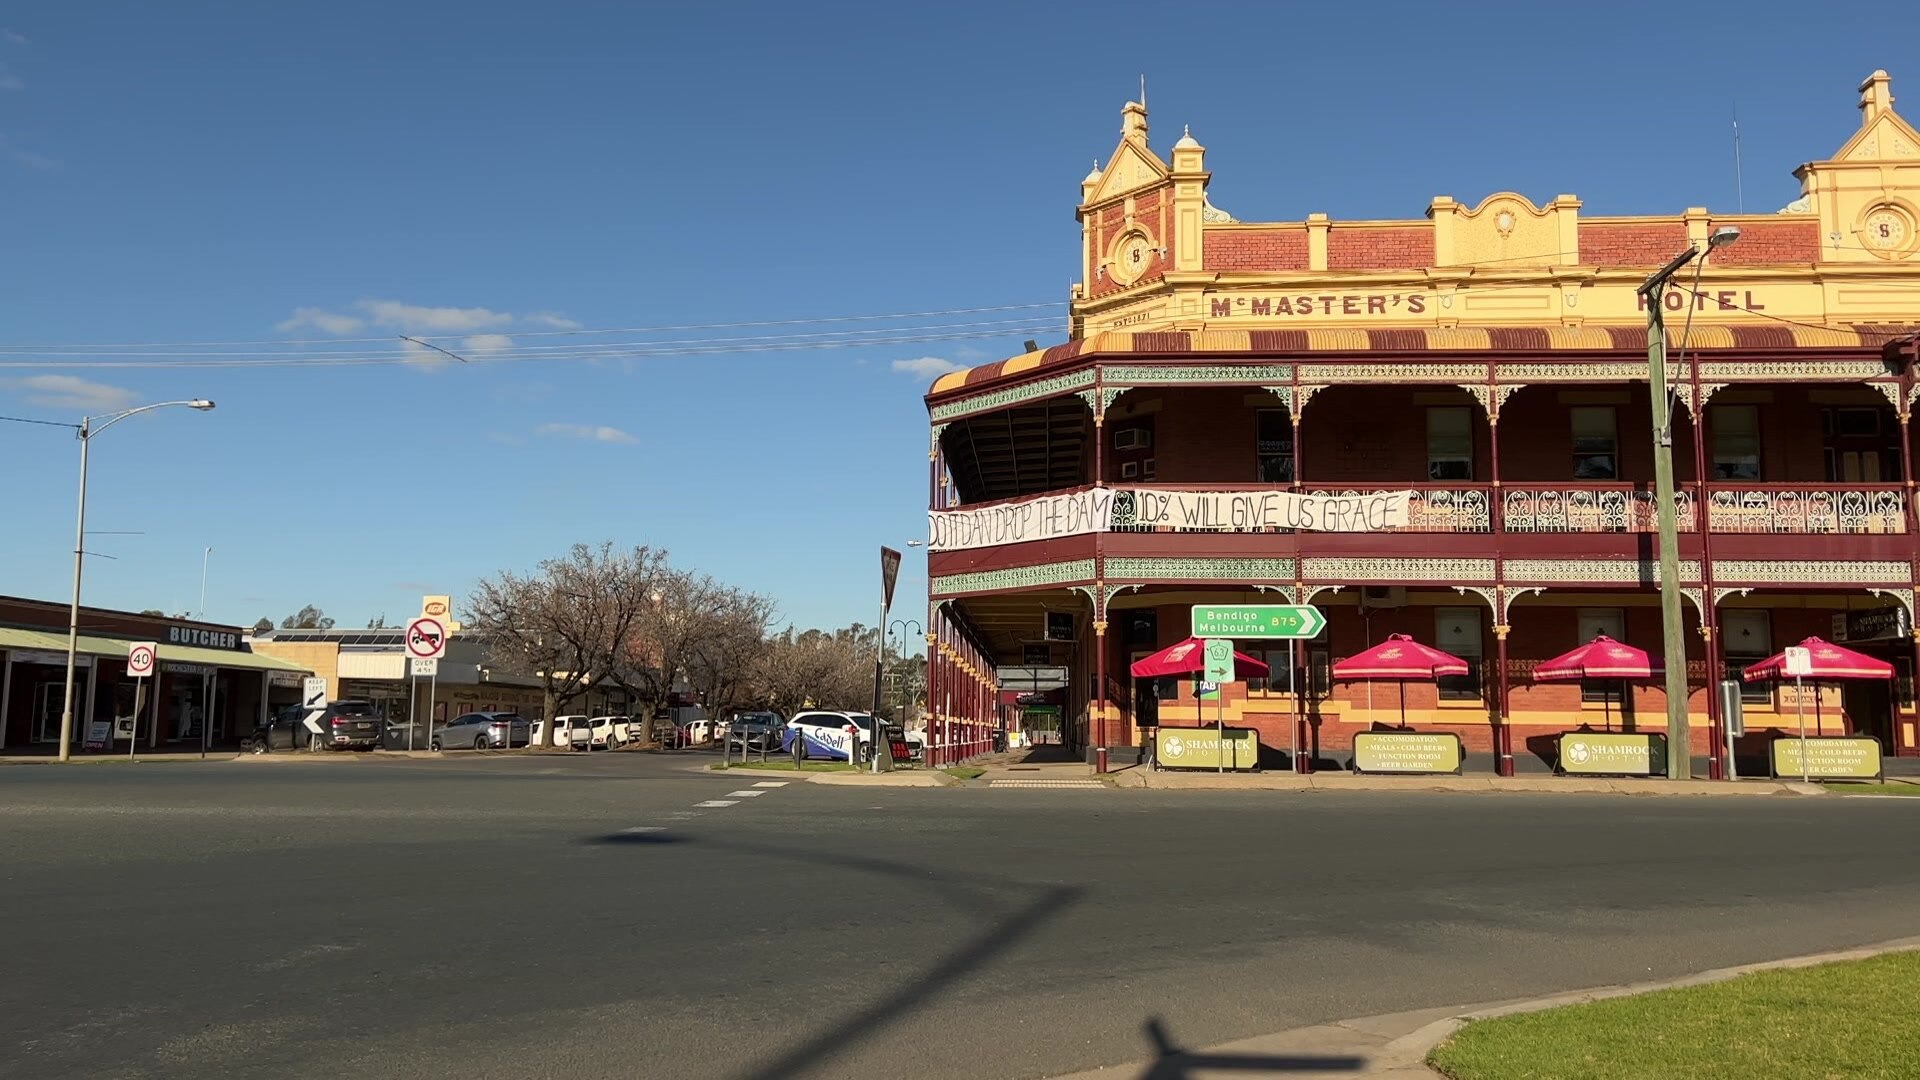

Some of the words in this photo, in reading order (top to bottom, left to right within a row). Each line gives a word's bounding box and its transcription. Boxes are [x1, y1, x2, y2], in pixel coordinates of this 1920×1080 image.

[1138, 492, 1171, 522] 10%
[1178, 496, 1228, 527] WILL
[1231, 494, 1279, 527] GIVE
[1287, 496, 1314, 528] US
[1322, 495, 1399, 531] GRACE
[928, 514, 946, 546] DO
[961, 511, 991, 545] DAN
[995, 504, 1032, 542] DROP
[1037, 499, 1063, 537] THE
[1067, 492, 1110, 532] DAM
[427, 604, 444, 613] IGA
[1207, 611, 1258, 622] Bendigo
[1271, 617, 1297, 626] B75
[1199, 623, 1266, 633] Melbourne
[170, 627, 236, 648] BUTCHER
[1214, 648, 1225, 657] 63
[133, 654, 149, 665] 40
[1199, 681, 1216, 691] TAB
[814, 727, 844, 749] Cadell
[1186, 740, 1250, 750] SHAMROCK
[1591, 745, 1658, 755] SHAMROCK
